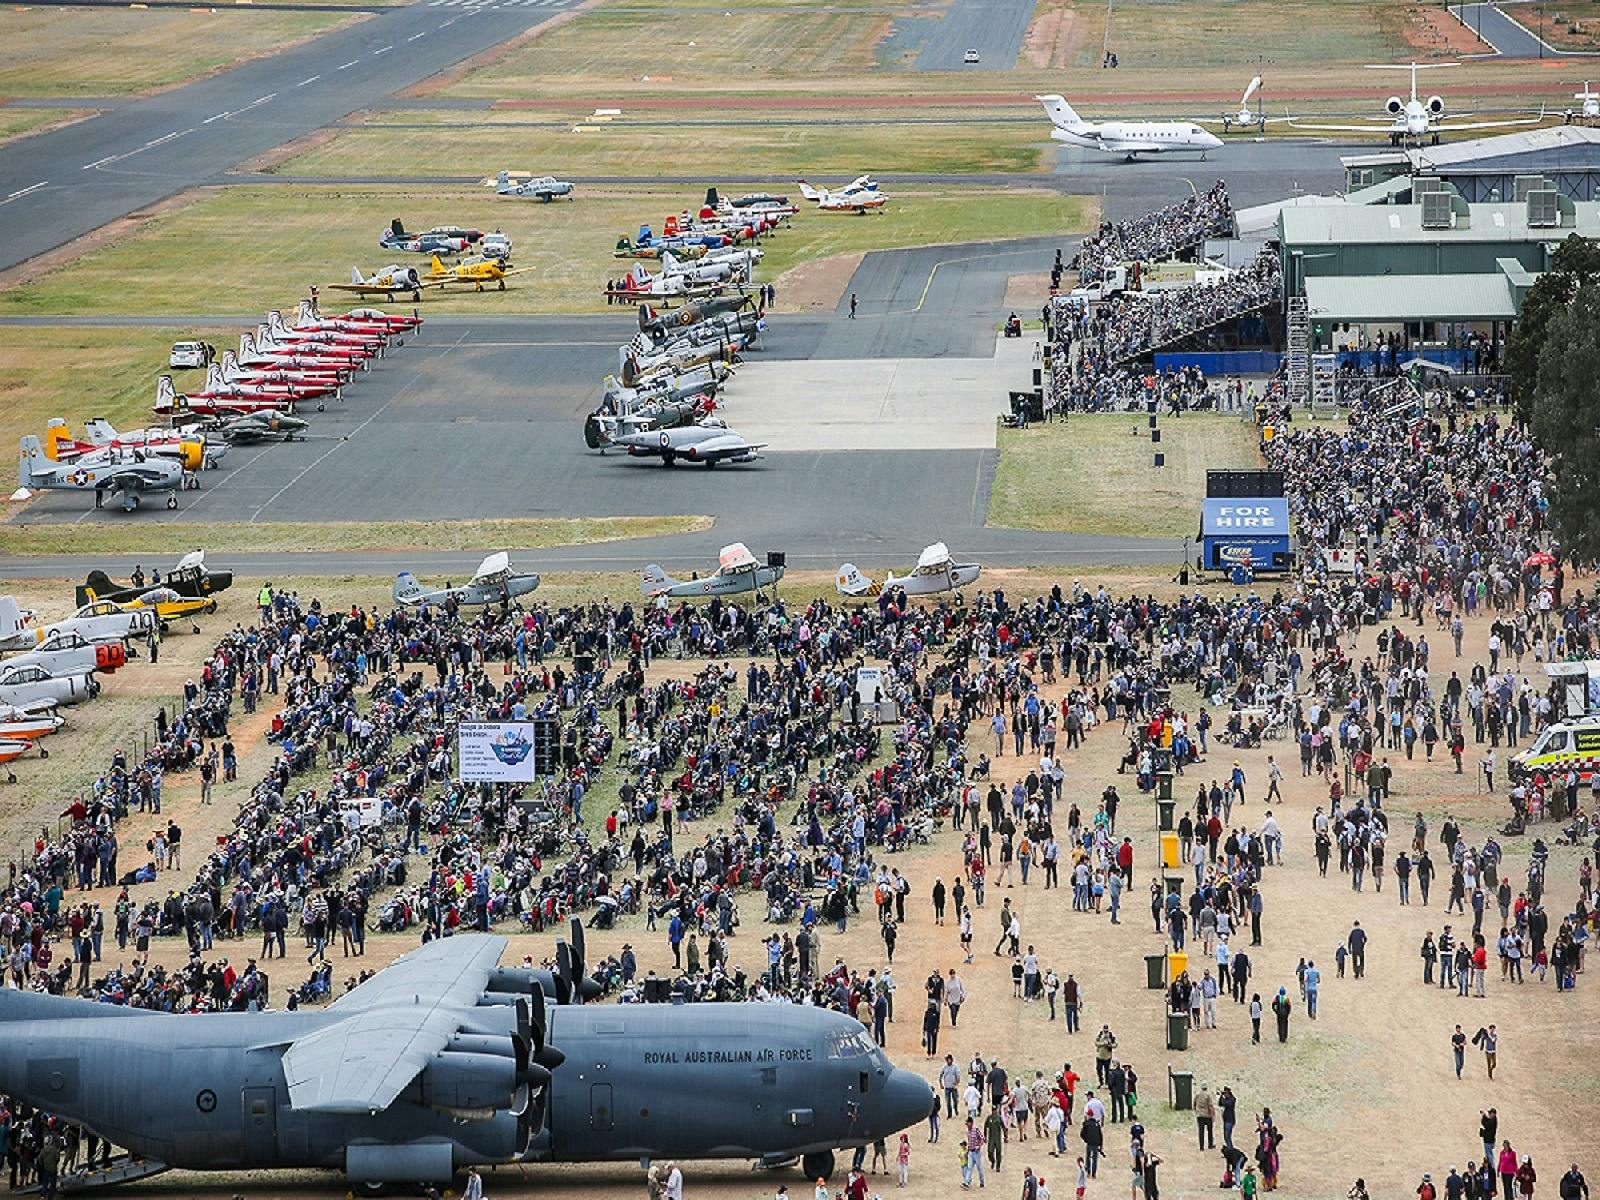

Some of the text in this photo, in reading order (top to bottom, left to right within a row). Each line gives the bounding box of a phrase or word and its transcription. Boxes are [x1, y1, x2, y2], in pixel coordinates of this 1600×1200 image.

[1220, 507, 1270, 516] FOR
[1216, 517, 1275, 527] HIRE
[644, 1049, 813, 1064] ROYAL AUSTRALIAN AIR FORCE
